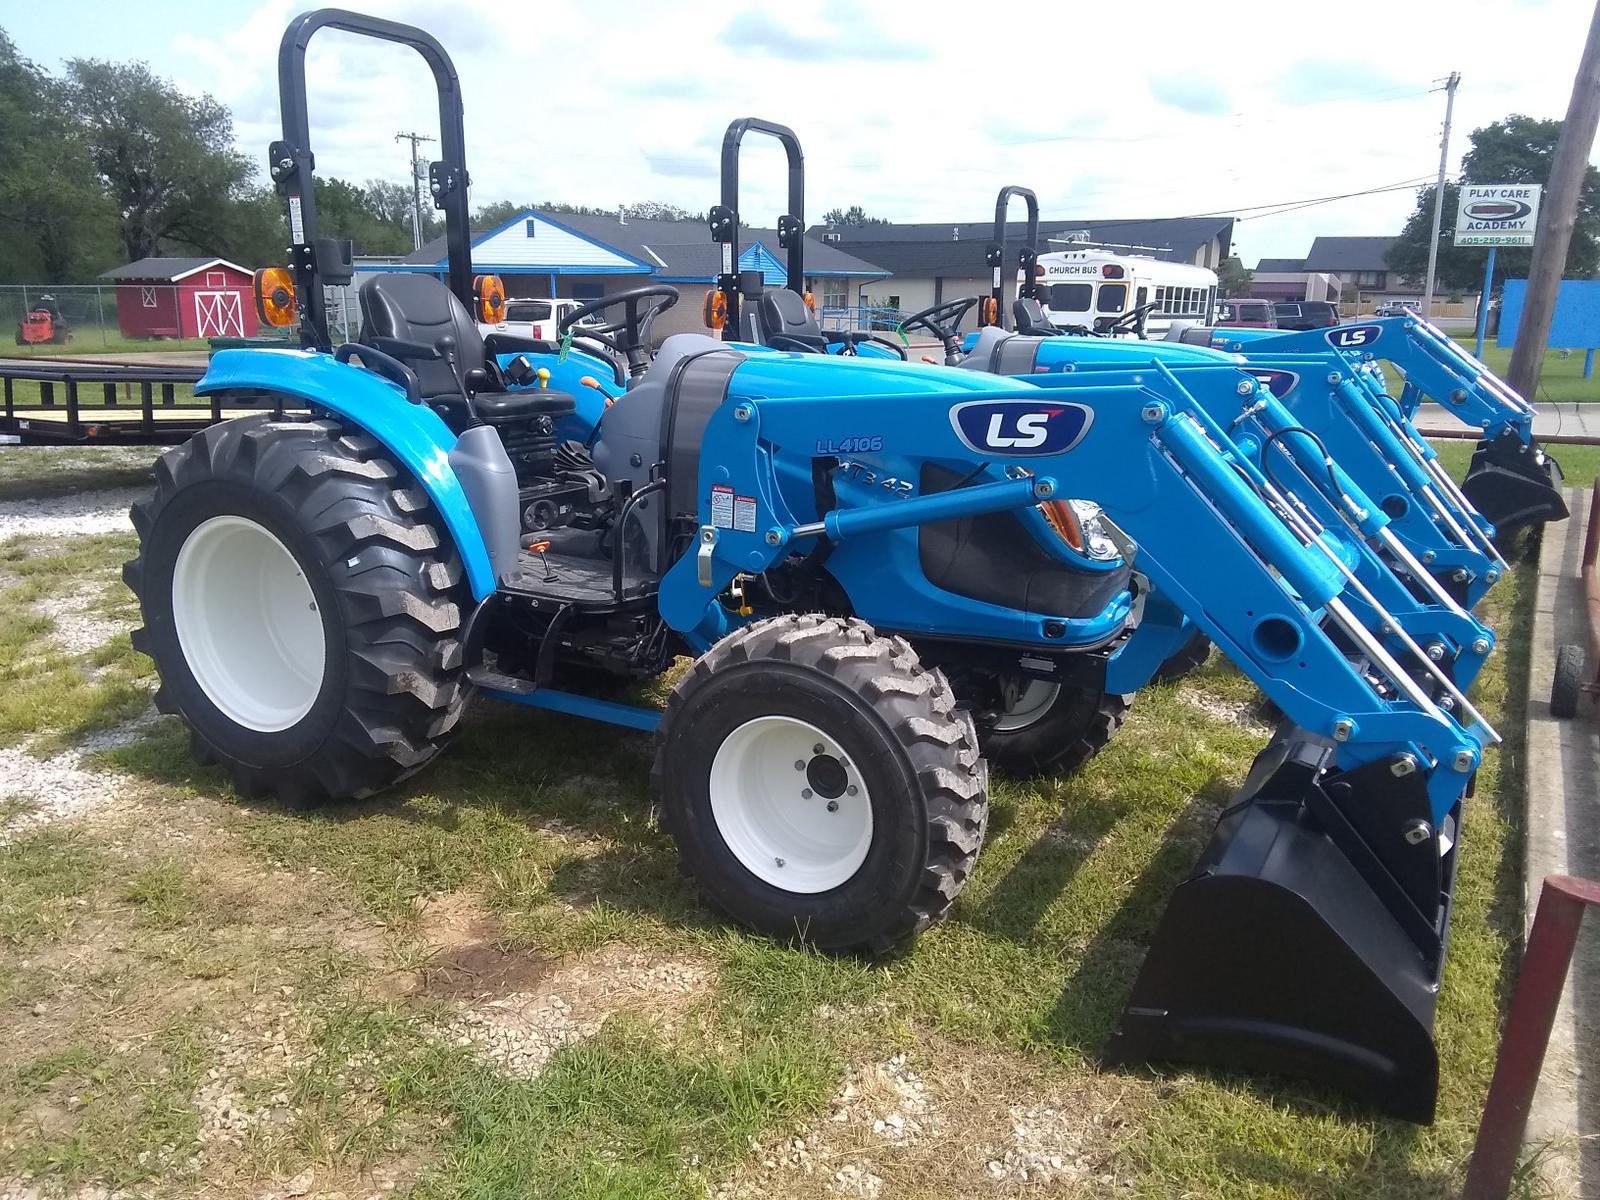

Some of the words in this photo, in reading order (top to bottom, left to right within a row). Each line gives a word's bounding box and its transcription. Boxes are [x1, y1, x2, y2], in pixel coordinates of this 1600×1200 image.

[1469, 189, 1497, 198] PLAY
[1500, 189, 1531, 198] CARE
[1466, 221, 1526, 230] ACADEMY
[1049, 266, 1080, 274] CHURCH
[1081, 266, 1098, 274] BUS
[1340, 330, 1366, 346] LS
[986, 413, 1049, 448] LS
[816, 436, 882, 454] LL4106
